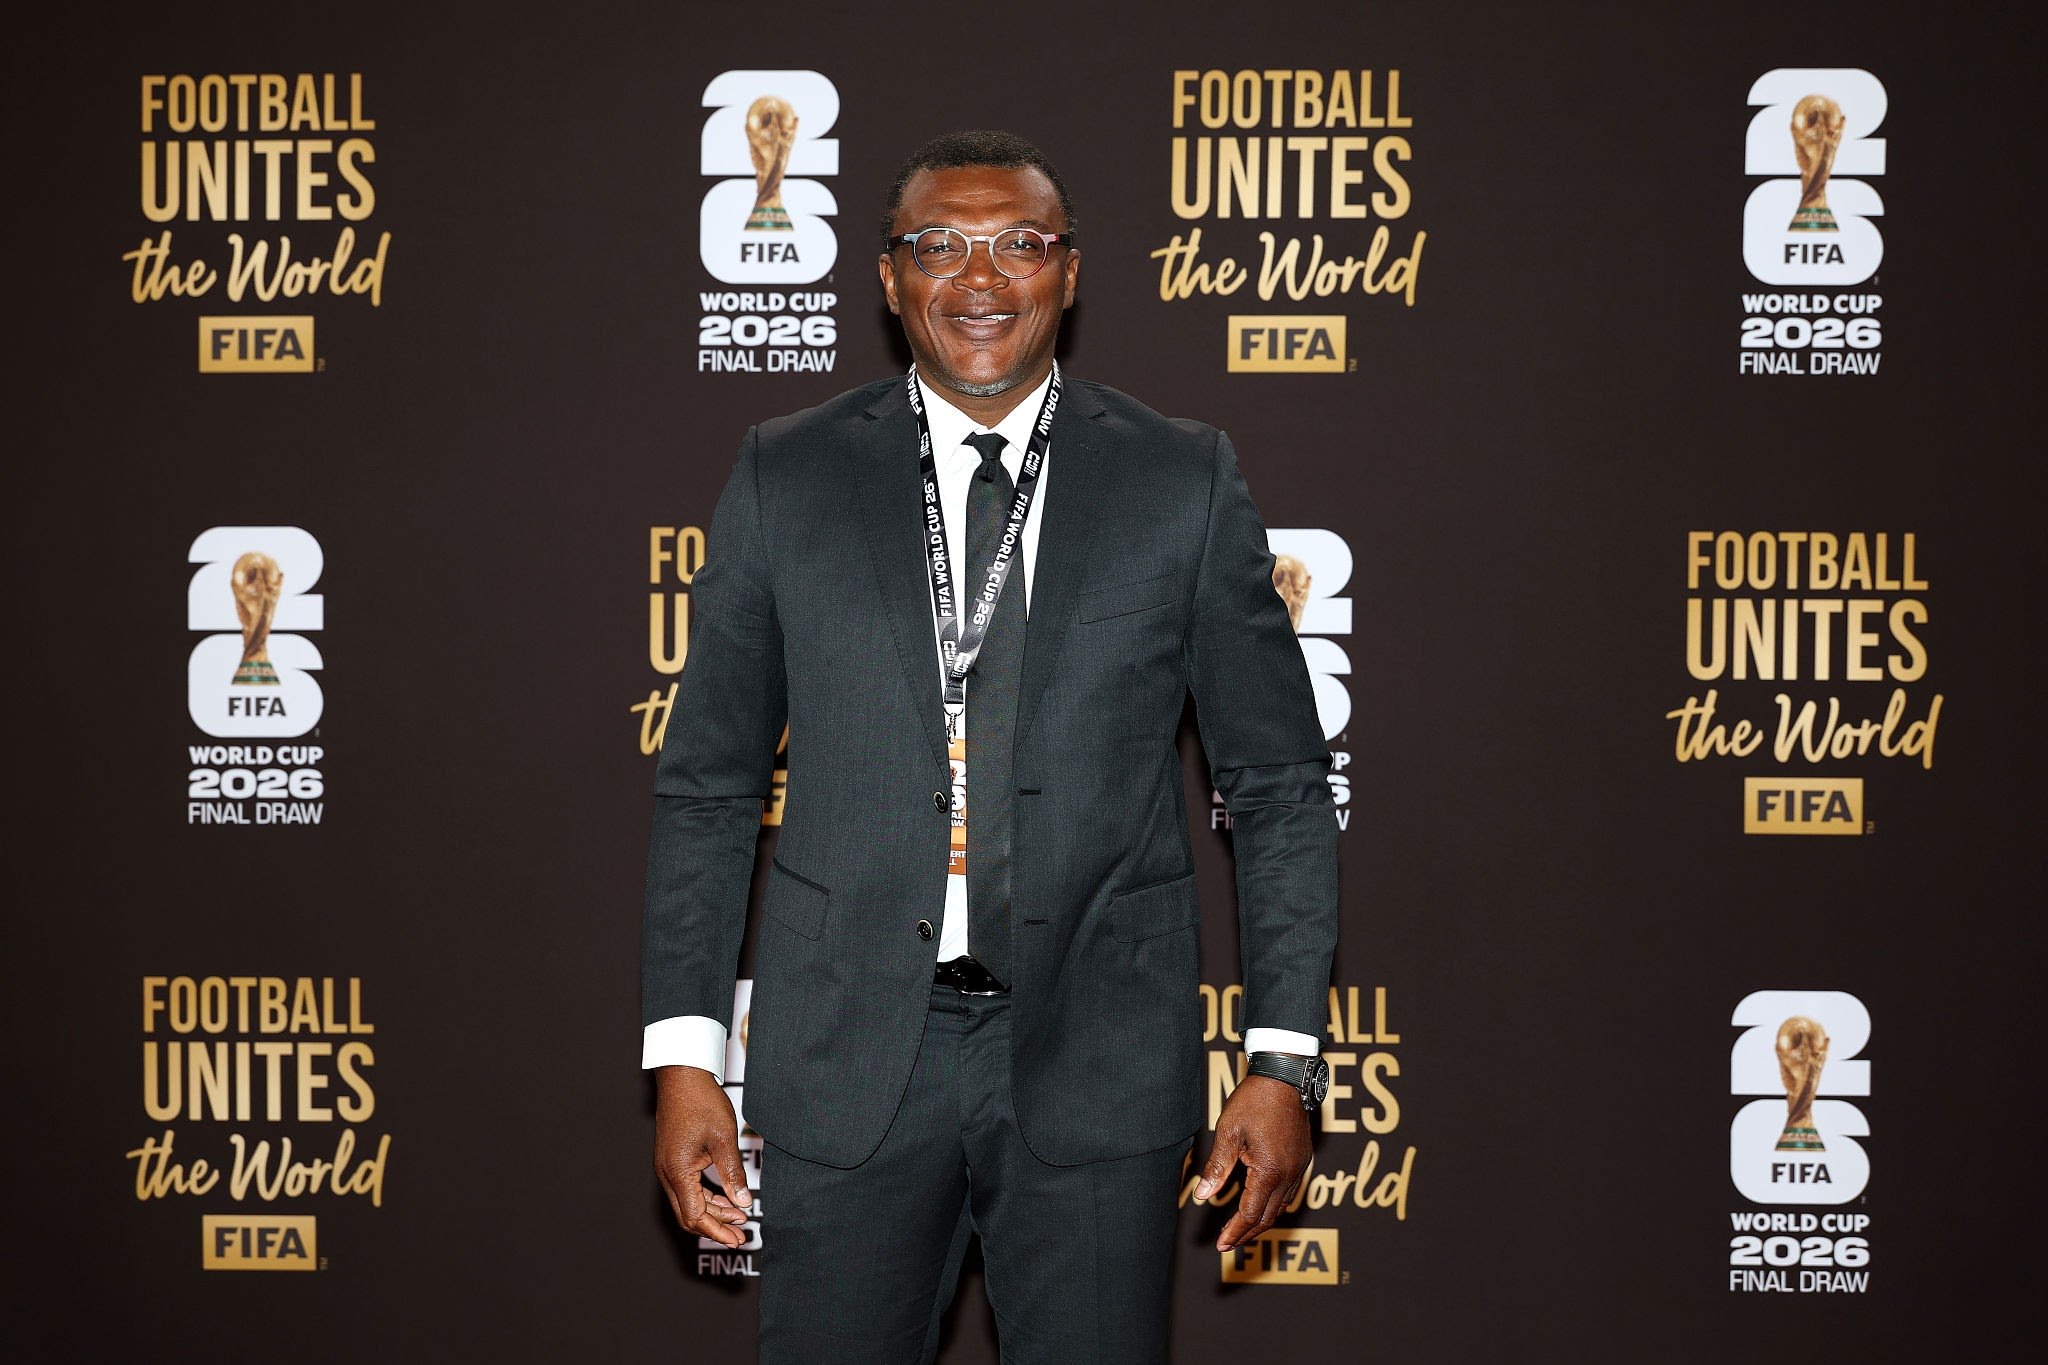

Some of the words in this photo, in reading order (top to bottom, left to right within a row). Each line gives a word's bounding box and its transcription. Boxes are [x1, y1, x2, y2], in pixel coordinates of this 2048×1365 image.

[143, 74, 375, 132] FOOTBALL
[1174, 70, 1412, 128] FOOTBALL
[143, 139, 374, 221] UNITES
[1172, 137, 1411, 219] UNITES
[123, 231, 216, 302] the
[228, 227, 390, 306] World
[741, 243, 799, 262] FIFA
[1151, 228, 1247, 301] the
[1258, 226, 1426, 306] World
[1785, 244, 1844, 264] FIFA
[700, 293, 786, 311] WORLD
[789, 293, 837, 311] CUP
[1742, 294, 1830, 313] WORLD
[1834, 295, 1882, 313] CUP
[212, 329, 304, 360] FIFA
[699, 316, 836, 346] 2026
[1241, 329, 1336, 360] FIFA
[1741, 318, 1881, 348] 2026
[699, 350, 762, 372] FINAL
[768, 350, 836, 372] DRAW
[1740, 352, 1804, 374] FINAL
[1811, 353, 1880, 374] DRAW
[1038, 388, 1060, 436] DRAW
[927, 507, 940, 533] CUP
[1011, 493, 1028, 521] FIFA
[931, 535, 948, 584] WORLD
[993, 523, 1020, 572] WORLD
[1689, 532, 1928, 590] FOOTBALL
[938, 585, 952, 617] FIFA
[983, 573, 1000, 602] CUP
[1687, 599, 1927, 681] UNITES
[229, 697, 286, 716] FIFA
[1667, 690, 1763, 762] the
[1775, 689, 1943, 768] World
[189, 746, 273, 764] WORLD
[277, 746, 323, 764] CUP
[189, 769, 323, 799] 2026
[189, 803, 250, 824] FINAL
[256, 803, 323, 824] DRAW
[1758, 790, 1853, 822] FIFA
[144, 977, 374, 1033] FOOTBALL
[1200, 984, 1400, 1044] OOALL
[145, 1042, 374, 1122] UNITES
[1208, 1050, 1400, 1134] NES
[127, 1130, 219, 1200] the
[230, 1129, 390, 1206] World
[1772, 1163, 1832, 1183] FIFA
[1731, 1213, 1818, 1231] WORLD
[1822, 1214, 1869, 1232] CUP
[216, 1227, 307, 1258] FIFA
[1234, 1240, 1329, 1272] FIFA
[1730, 1236, 1869, 1267] 2026
[698, 1254, 761, 1277] FINAL
[1730, 1270, 1794, 1292] FINAL
[1800, 1271, 1869, 1292] DRAW
